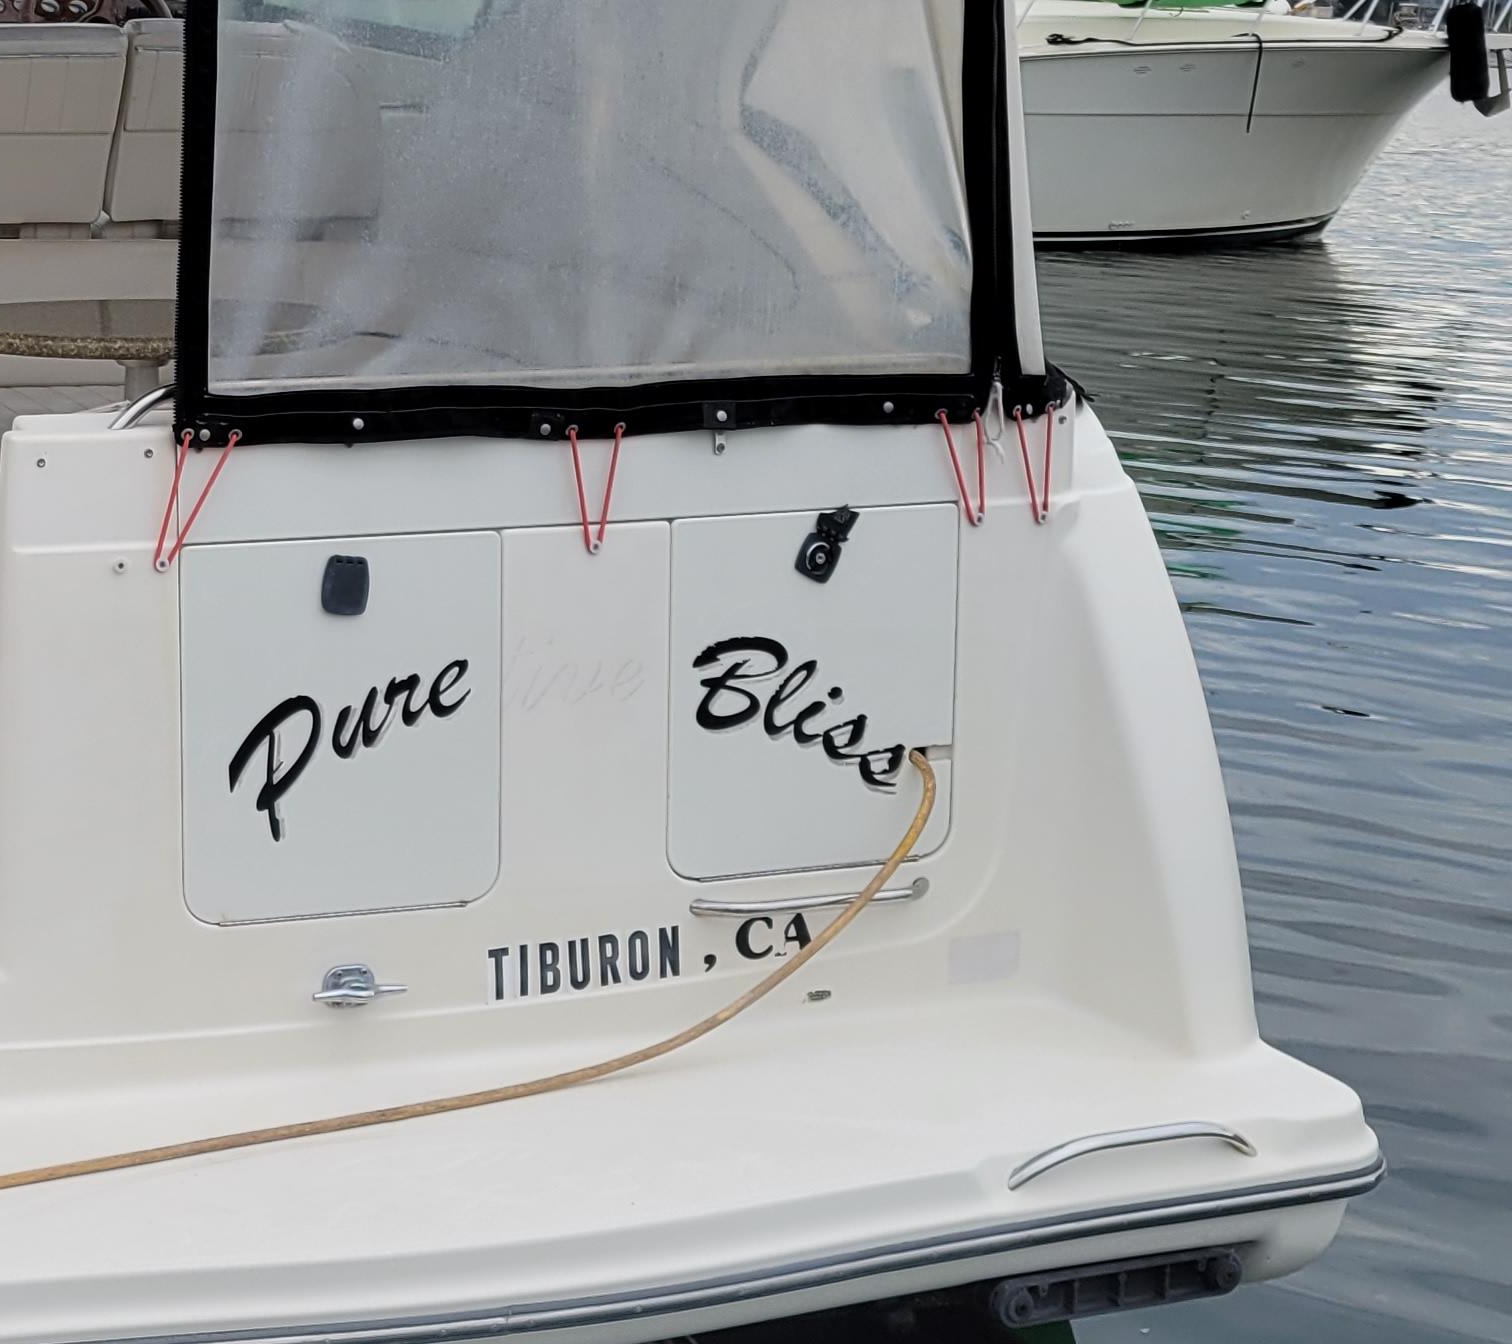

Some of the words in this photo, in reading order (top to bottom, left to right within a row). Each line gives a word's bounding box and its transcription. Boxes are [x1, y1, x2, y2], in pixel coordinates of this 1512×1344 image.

[228, 658, 472, 843] Pure
[691, 636, 906, 790] Bliss
[735, 912, 813, 960] CA
